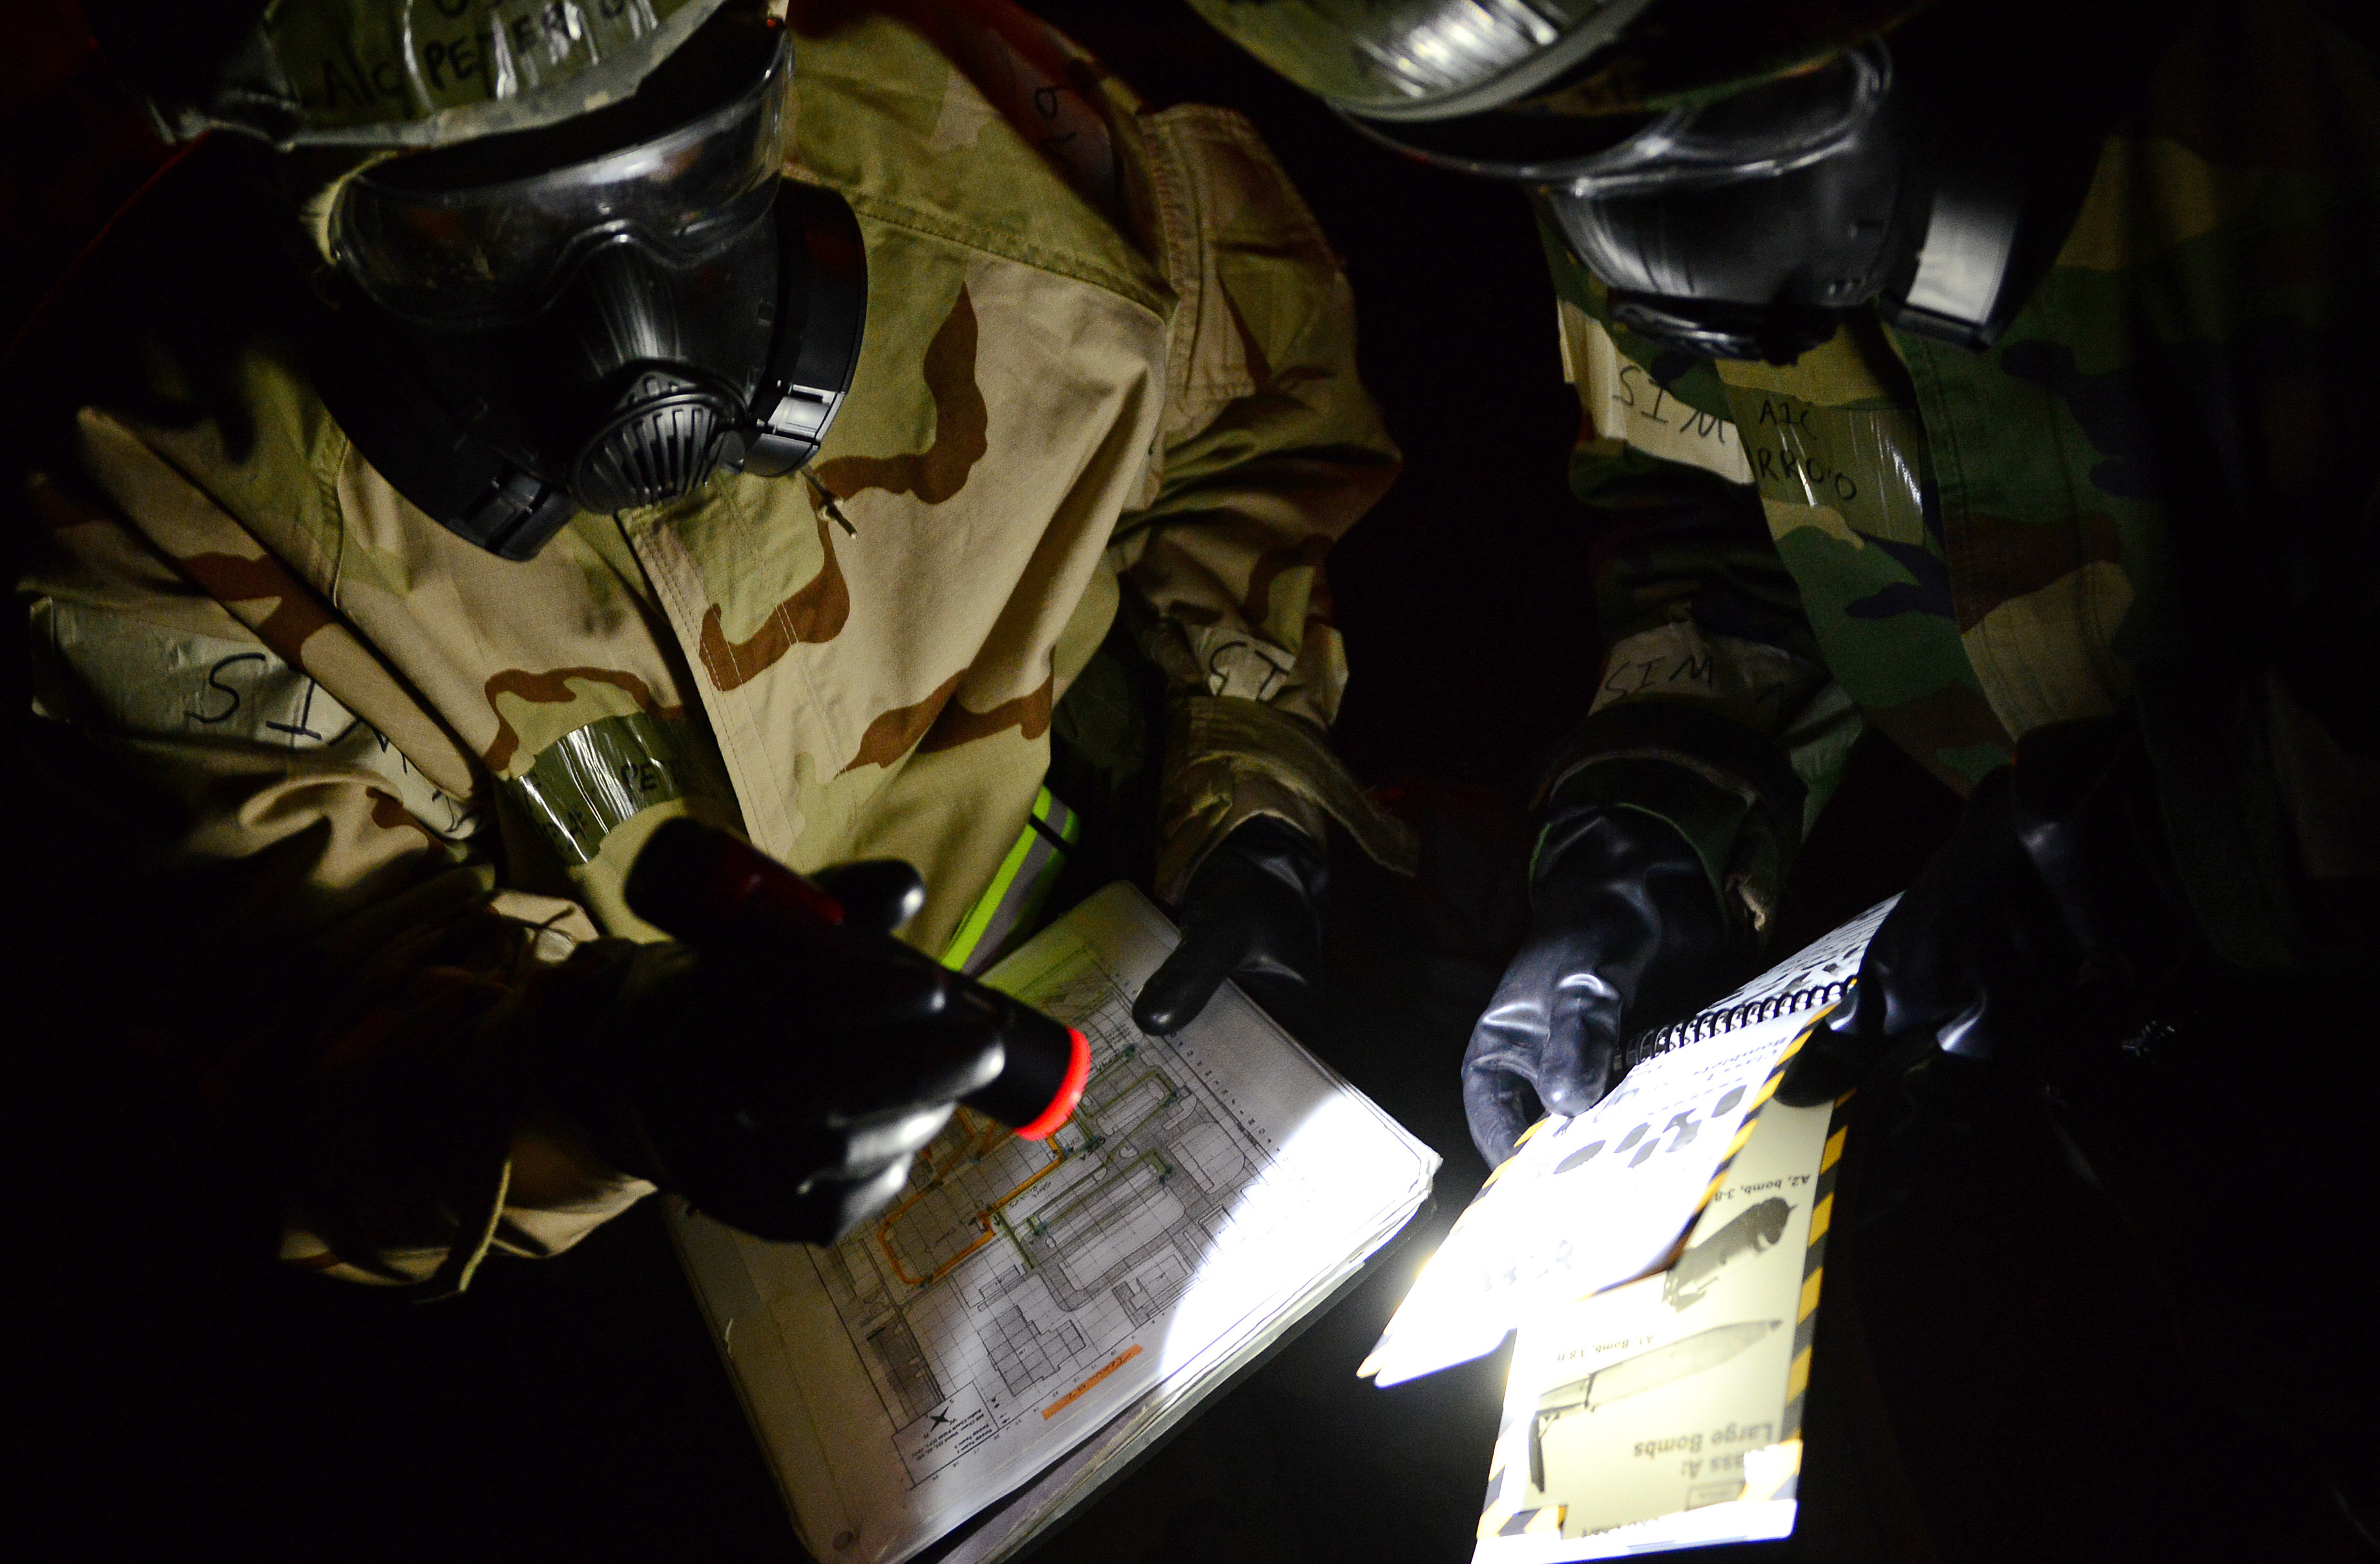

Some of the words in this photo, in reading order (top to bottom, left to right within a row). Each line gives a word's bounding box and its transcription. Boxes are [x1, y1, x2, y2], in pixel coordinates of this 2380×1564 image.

[1611, 364, 1726, 444] SIM
[1603, 654, 1715, 704] SIM
[1740, 1179, 1782, 1196] bomb,
[1788, 1174, 1811, 1187] A2,
[1592, 1339, 1629, 1353] Bomb,
[1711, 1421, 1773, 1446] Large
[1633, 1432, 1704, 1459] Bombs
[1680, 1458, 1704, 1479] A:
